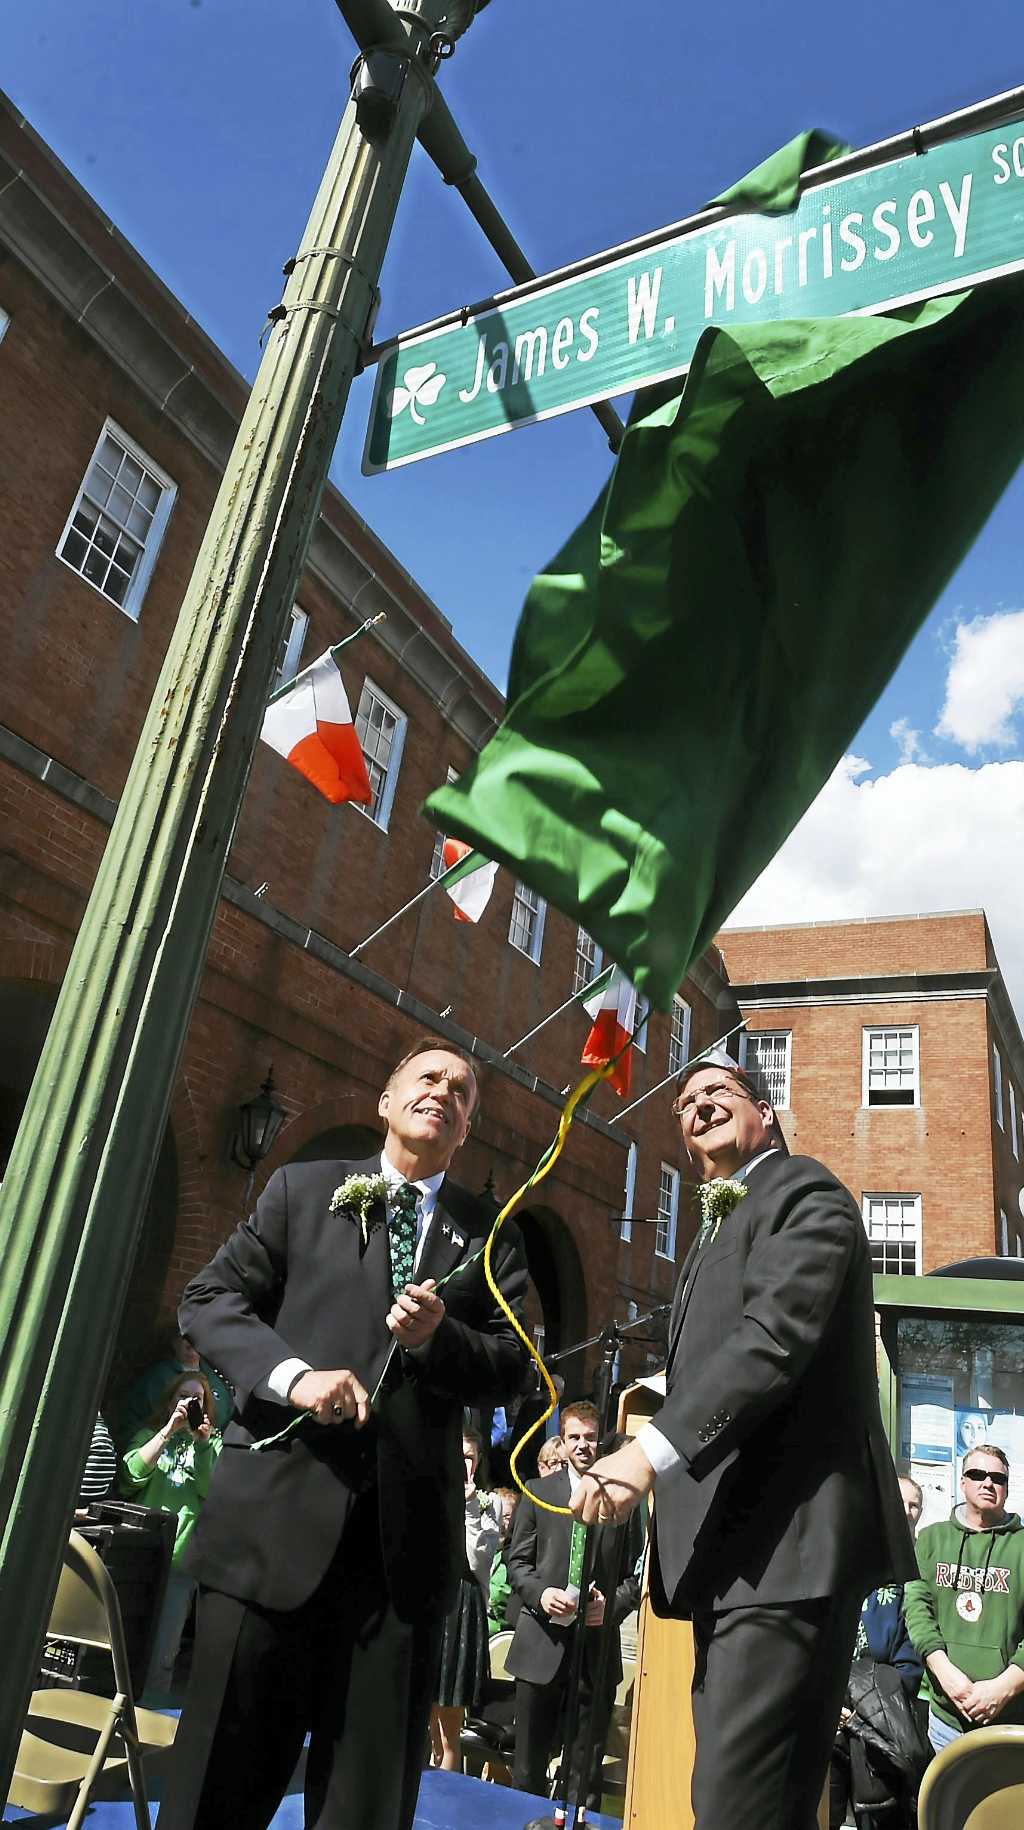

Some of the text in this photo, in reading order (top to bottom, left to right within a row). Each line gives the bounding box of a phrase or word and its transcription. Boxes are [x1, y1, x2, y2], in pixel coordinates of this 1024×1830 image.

[458, 306, 600, 404] James
[627, 266, 676, 346] W.
[703, 172, 973, 319] Morrissey
